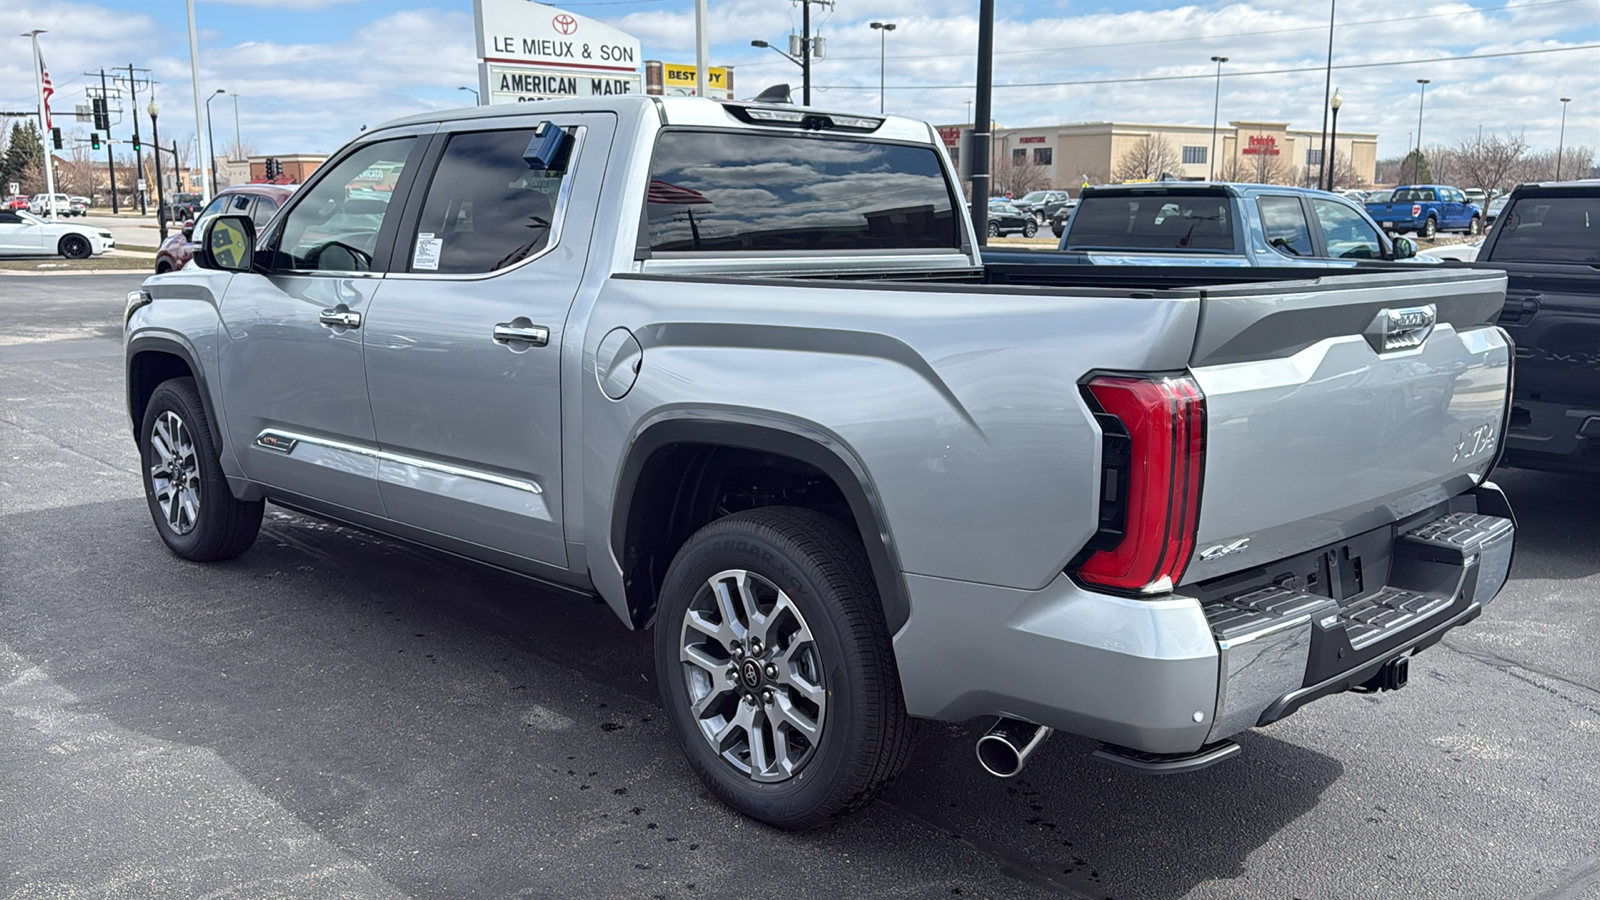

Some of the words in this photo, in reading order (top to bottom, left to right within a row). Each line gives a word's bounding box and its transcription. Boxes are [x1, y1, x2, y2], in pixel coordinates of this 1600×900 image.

[494, 36, 515, 53] LE
[523, 38, 574, 58] MIEUX
[582, 43, 592, 59] &
[600, 44, 634, 62] SON
[500, 73, 577, 95] AMERICAN
[591, 78, 631, 95] MADE
[668, 70, 696, 81] BEST
